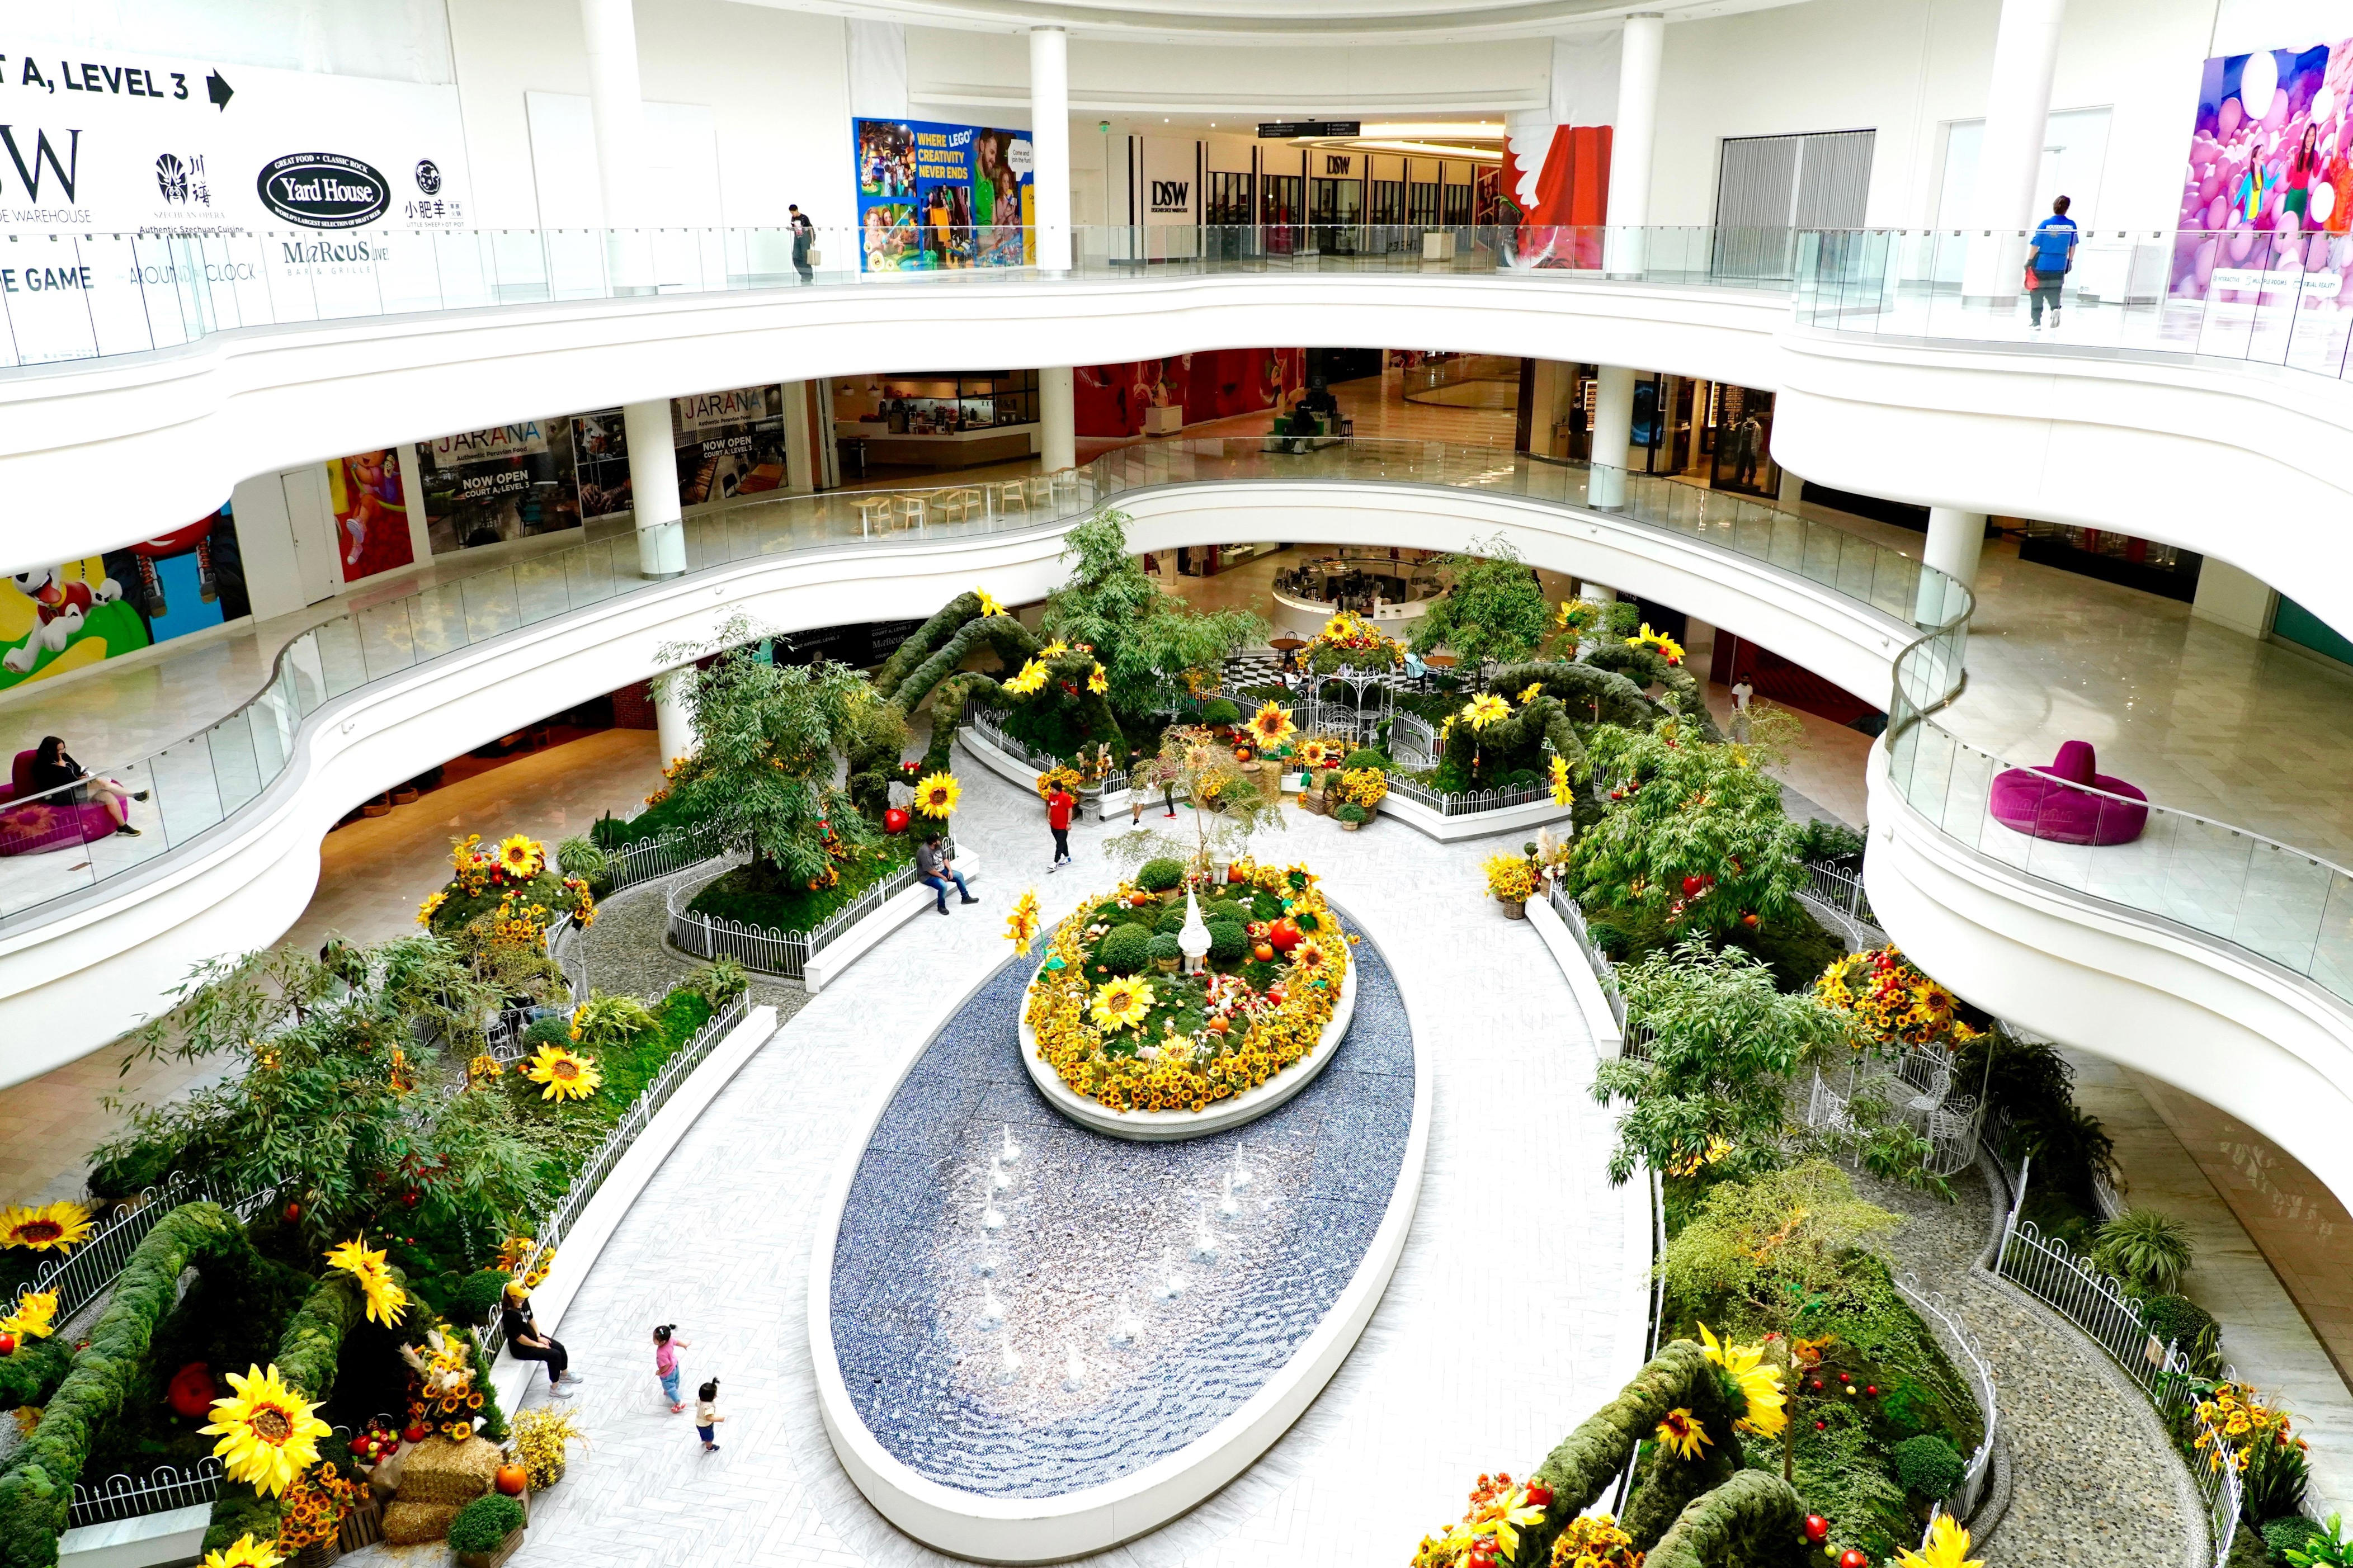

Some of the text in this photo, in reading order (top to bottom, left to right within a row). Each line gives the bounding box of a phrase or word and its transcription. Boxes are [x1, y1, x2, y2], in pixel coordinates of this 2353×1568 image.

[22, 56, 54, 94] A,
[62, 61, 164, 98] LEVEL
[170, 73, 188, 100] 3
[917, 133, 947, 147] WHERE
[275, 155, 368, 173] GREAT FOOD CLASSIC ROCK
[918, 149, 964, 164] CREATIVITY
[1327, 155, 1351, 175] DSW
[919, 165, 968, 180] NEVER ENDS
[280, 178, 322, 201] Yard
[1152, 181, 1189, 206] DSW
[12, 210, 91, 223] WAREHOUSE
[298, 217, 321, 226] LARGEST
[370, 209, 381, 219] BEER
[405, 199, 446, 219] 小肥羊
[25, 267, 95, 291] GAME
[130, 265, 190, 285] AROUND
[206, 263, 256, 281] CLOCK
[331, 266, 370, 275] GRILLE
[686, 391, 762, 419] JARANA
[438, 421, 541, 453] JARANA
[702, 436, 752, 452] NOW OPEN
[456, 452, 485, 461] Authentic
[487, 448, 512, 457] Peruvian
[704, 450, 723, 459] COURT
[463, 470, 529, 490] NOW OPEN
[465, 488, 491, 498] COURT
[502, 483, 524, 493] LEVEL
